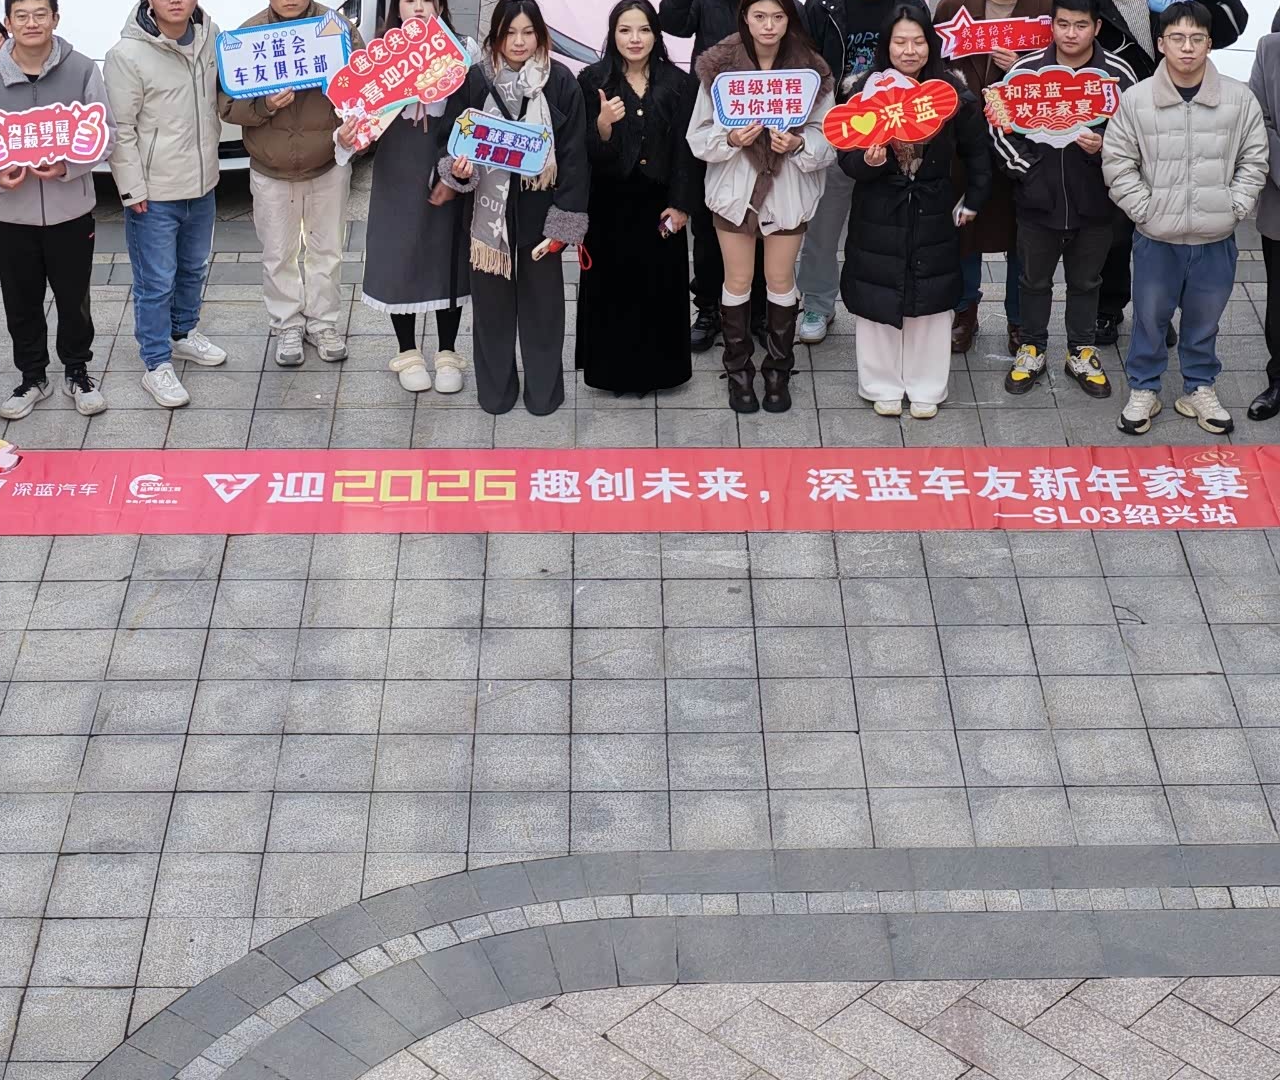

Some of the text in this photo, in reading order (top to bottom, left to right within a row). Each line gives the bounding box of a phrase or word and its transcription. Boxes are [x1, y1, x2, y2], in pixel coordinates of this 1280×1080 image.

[961, 23, 1014, 38] 我在绍兴
[252, 35, 306, 61] 兴蓝会
[353, 21, 423, 73] 蓝友共聚
[234, 54, 328, 86] 车友俱乐部
[360, 34, 447, 106] 喜迎2026
[728, 78, 803, 96] 超级增程
[1004, 79, 1102, 100] 和深蓝一起
[729, 98, 803, 116] 为你增程
[880, 95, 939, 132] 深蓝
[1015, 99, 1093, 118] 欢乐家宴
[8, 119, 70, 136] 央企销冠
[8, 132, 70, 150] 信赖之选
[472, 124, 543, 153] 就要这样
[11, 482, 99, 497] 深蓝汽车
